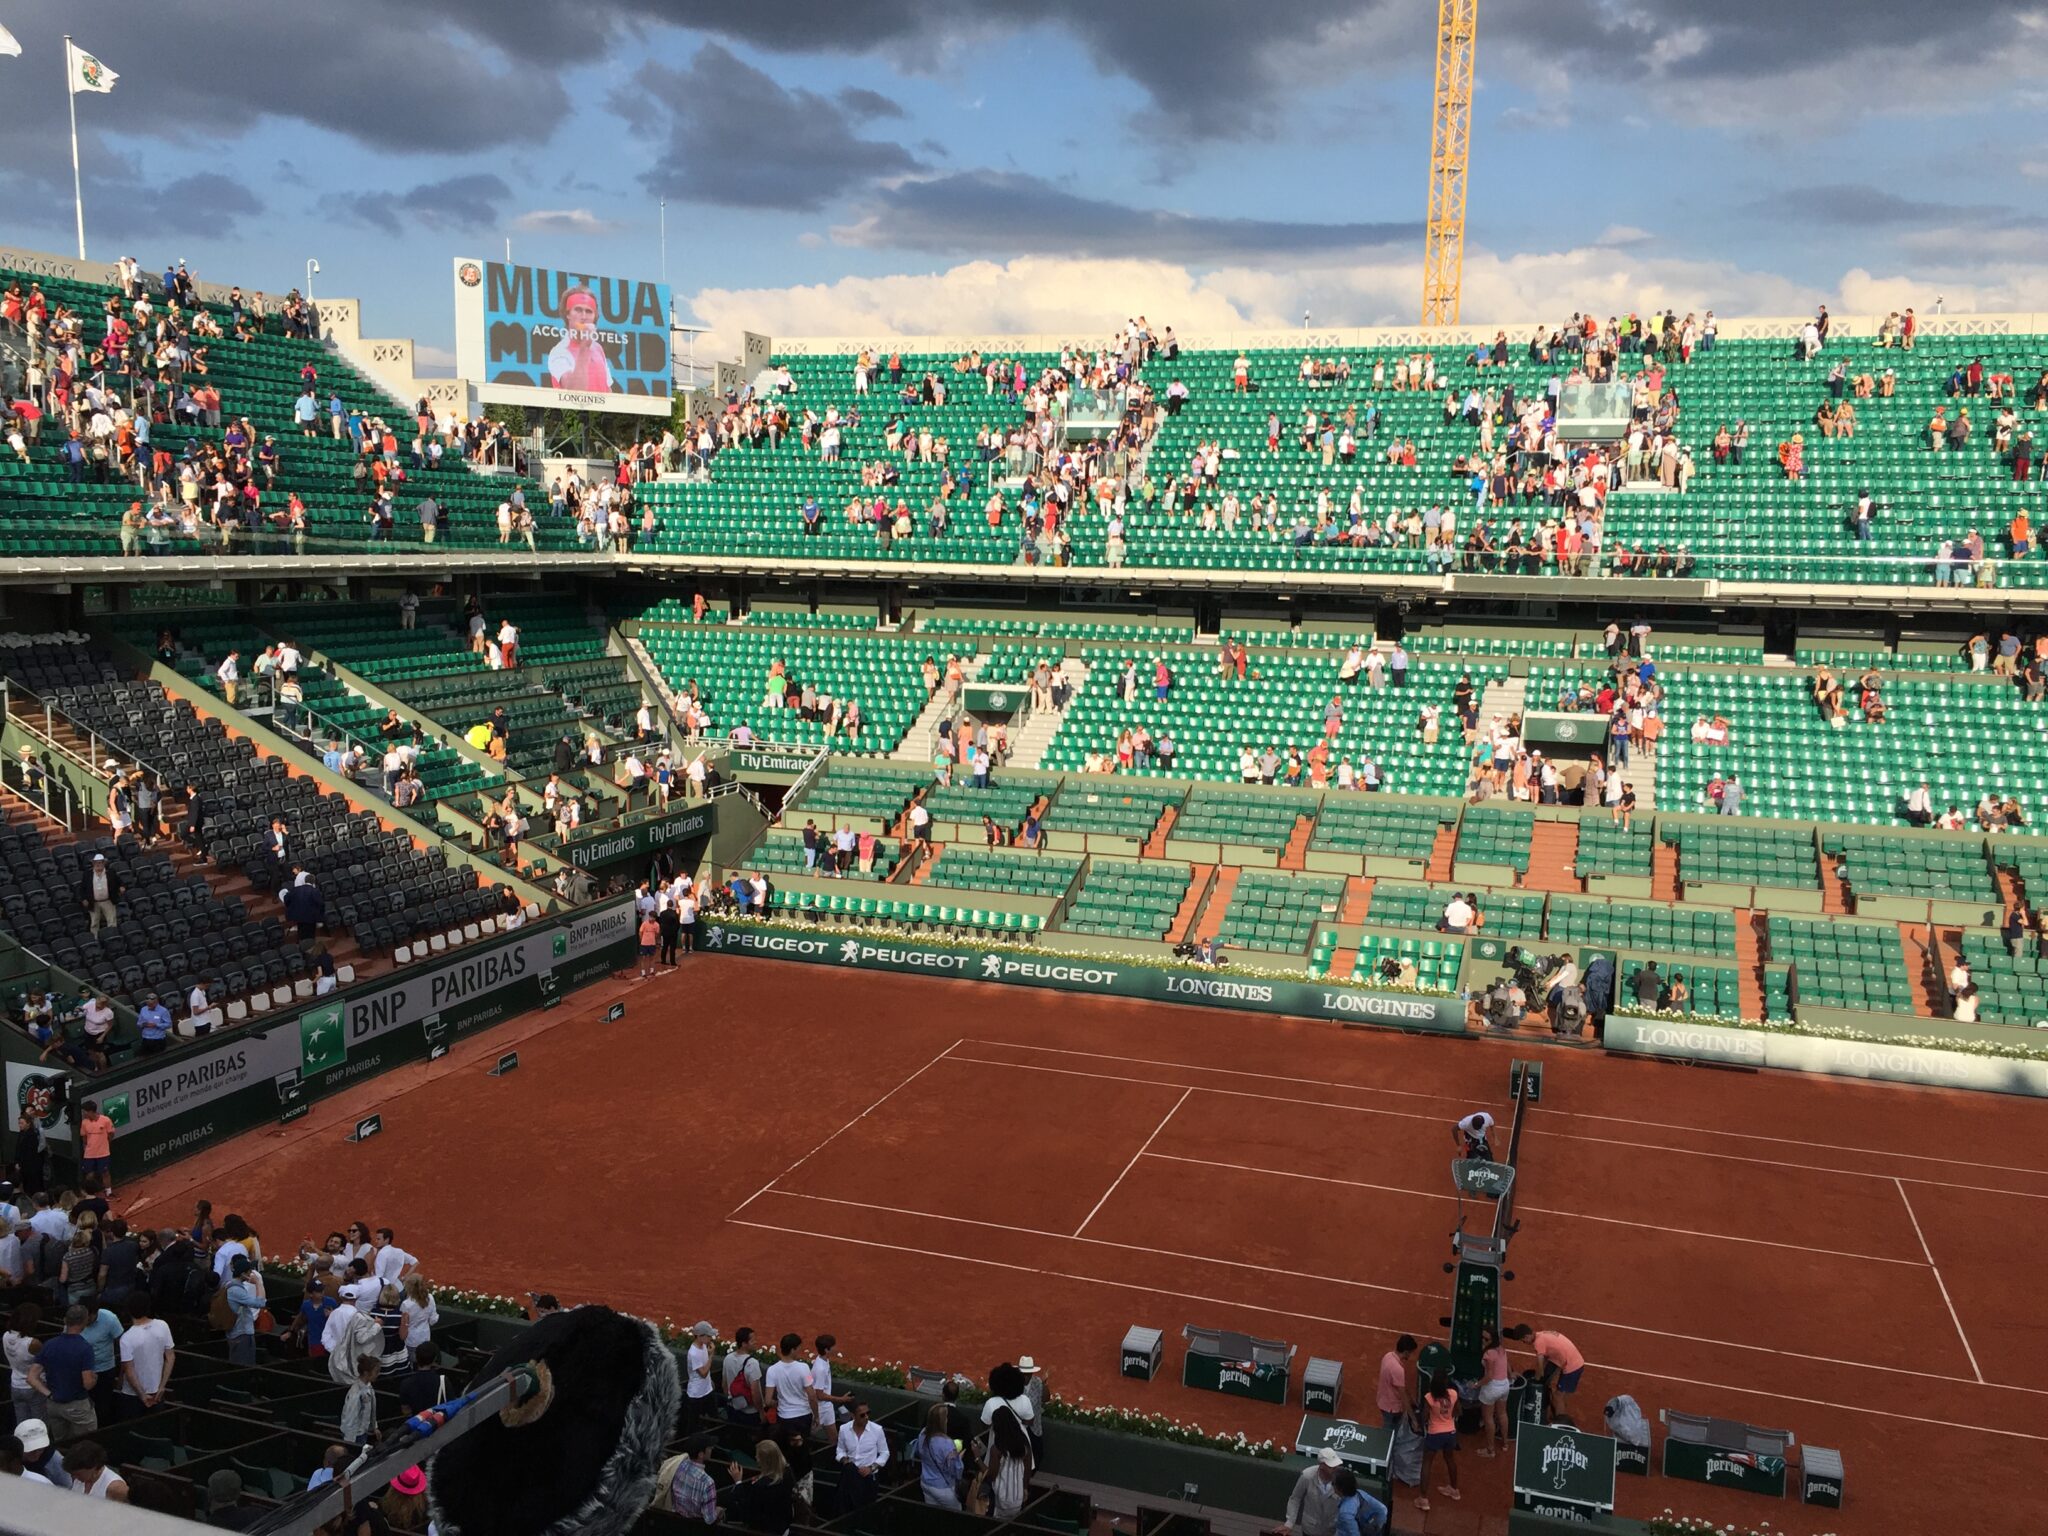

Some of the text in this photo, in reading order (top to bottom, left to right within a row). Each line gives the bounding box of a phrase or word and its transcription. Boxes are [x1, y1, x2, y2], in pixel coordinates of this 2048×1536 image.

[487, 262, 665, 327] MUTUA
[558, 393, 606, 405] LONGINES
[740, 753, 761, 770] Fly
[648, 815, 704, 844] Fly Emirates
[572, 835, 635, 867] Fly Emirates
[569, 926, 589, 945] BNP
[590, 911, 627, 937] PARIBAS
[727, 933, 829, 955] PEUGEOT
[861, 946, 970, 970] PEUGEOT
[1004, 960, 1119, 985] PEUGEOT
[352, 945, 526, 1038] BNP PARIBAS
[1166, 976, 1273, 1003] LONGINES
[457, 1004, 503, 1031] BNP PARIBAS
[1323, 993, 1436, 1020] LONGINES
[1635, 1026, 1765, 1057] LONGINES
[326, 1054, 382, 1085] BNP PARIBAS
[1834, 1049, 1969, 1078] LONGINES
[136, 1050, 247, 1108] BNP PARIBAS
[281, 1104, 308, 1120] LACOSTE
[143, 1122, 214, 1162] BNP PARIBAS
[1123, 1355, 1149, 1371] perrier
[1305, 1389, 1333, 1405] perrier
[1323, 1426, 1368, 1443] perrier
[1541, 1443, 1589, 1474] perrier
[1616, 1449, 1647, 1466] perrier
[1705, 1458, 1745, 1480] perrier
[1806, 1481, 1839, 1498] perrier
